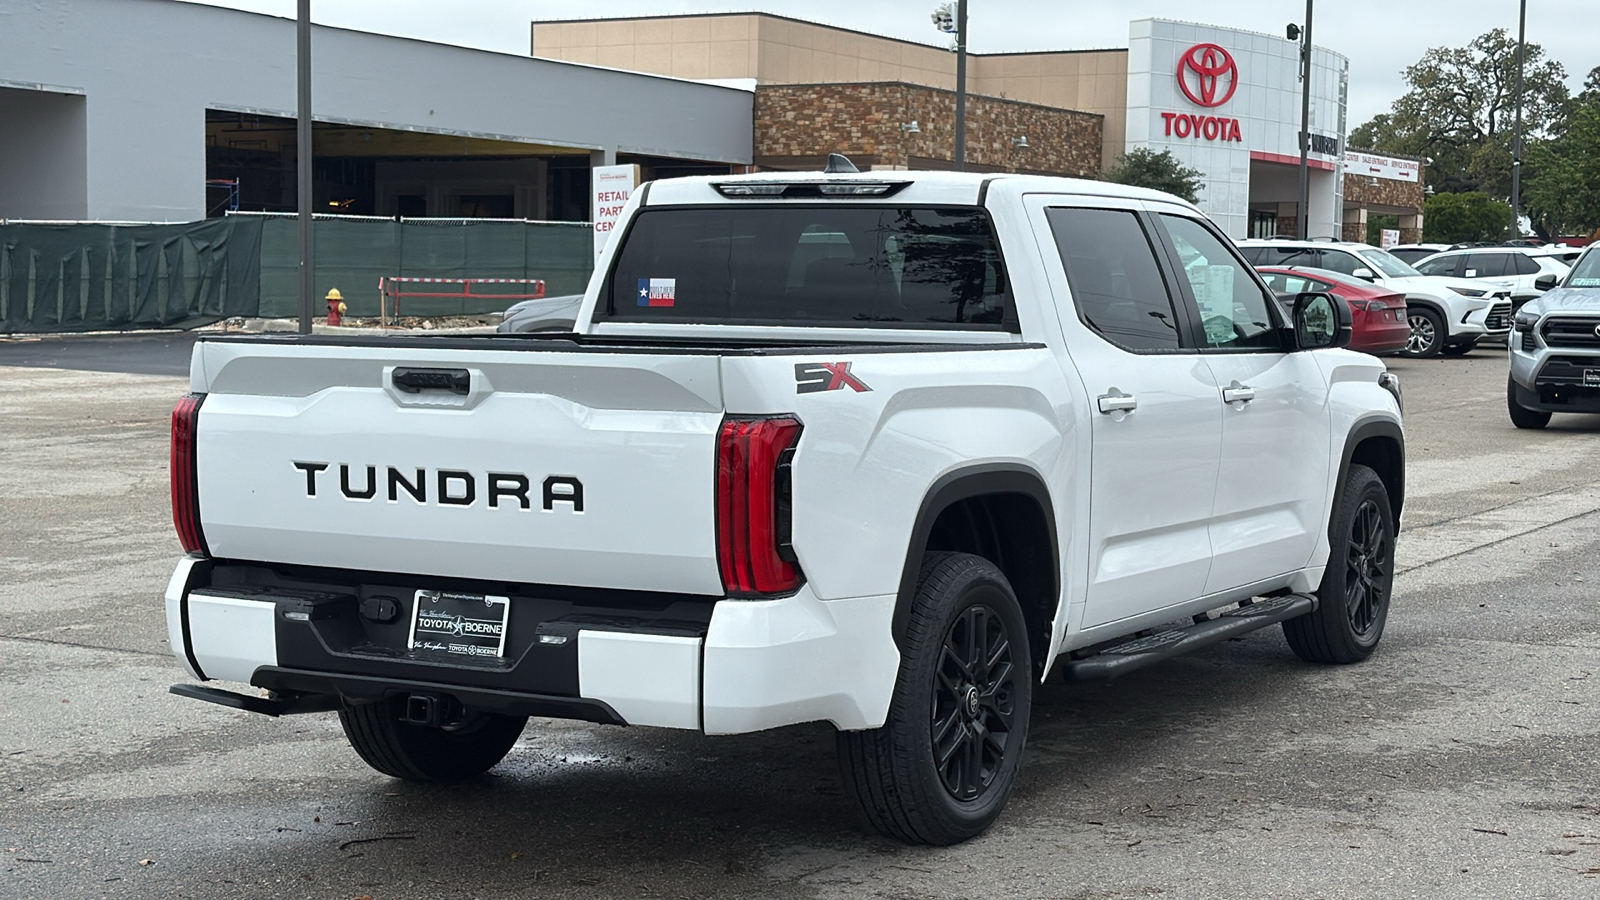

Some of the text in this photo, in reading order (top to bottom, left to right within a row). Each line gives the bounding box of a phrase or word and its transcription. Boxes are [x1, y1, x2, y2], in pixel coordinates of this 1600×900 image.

[1161, 112, 1242, 142] TOYOTA
[598, 191, 629, 202] RETAIL
[599, 206, 623, 218] PART
[595, 221, 616, 232] CEN
[292, 461, 585, 514] TUNDRA
[418, 618, 453, 629] TOYOTA
[465, 622, 502, 634] BOERNE
